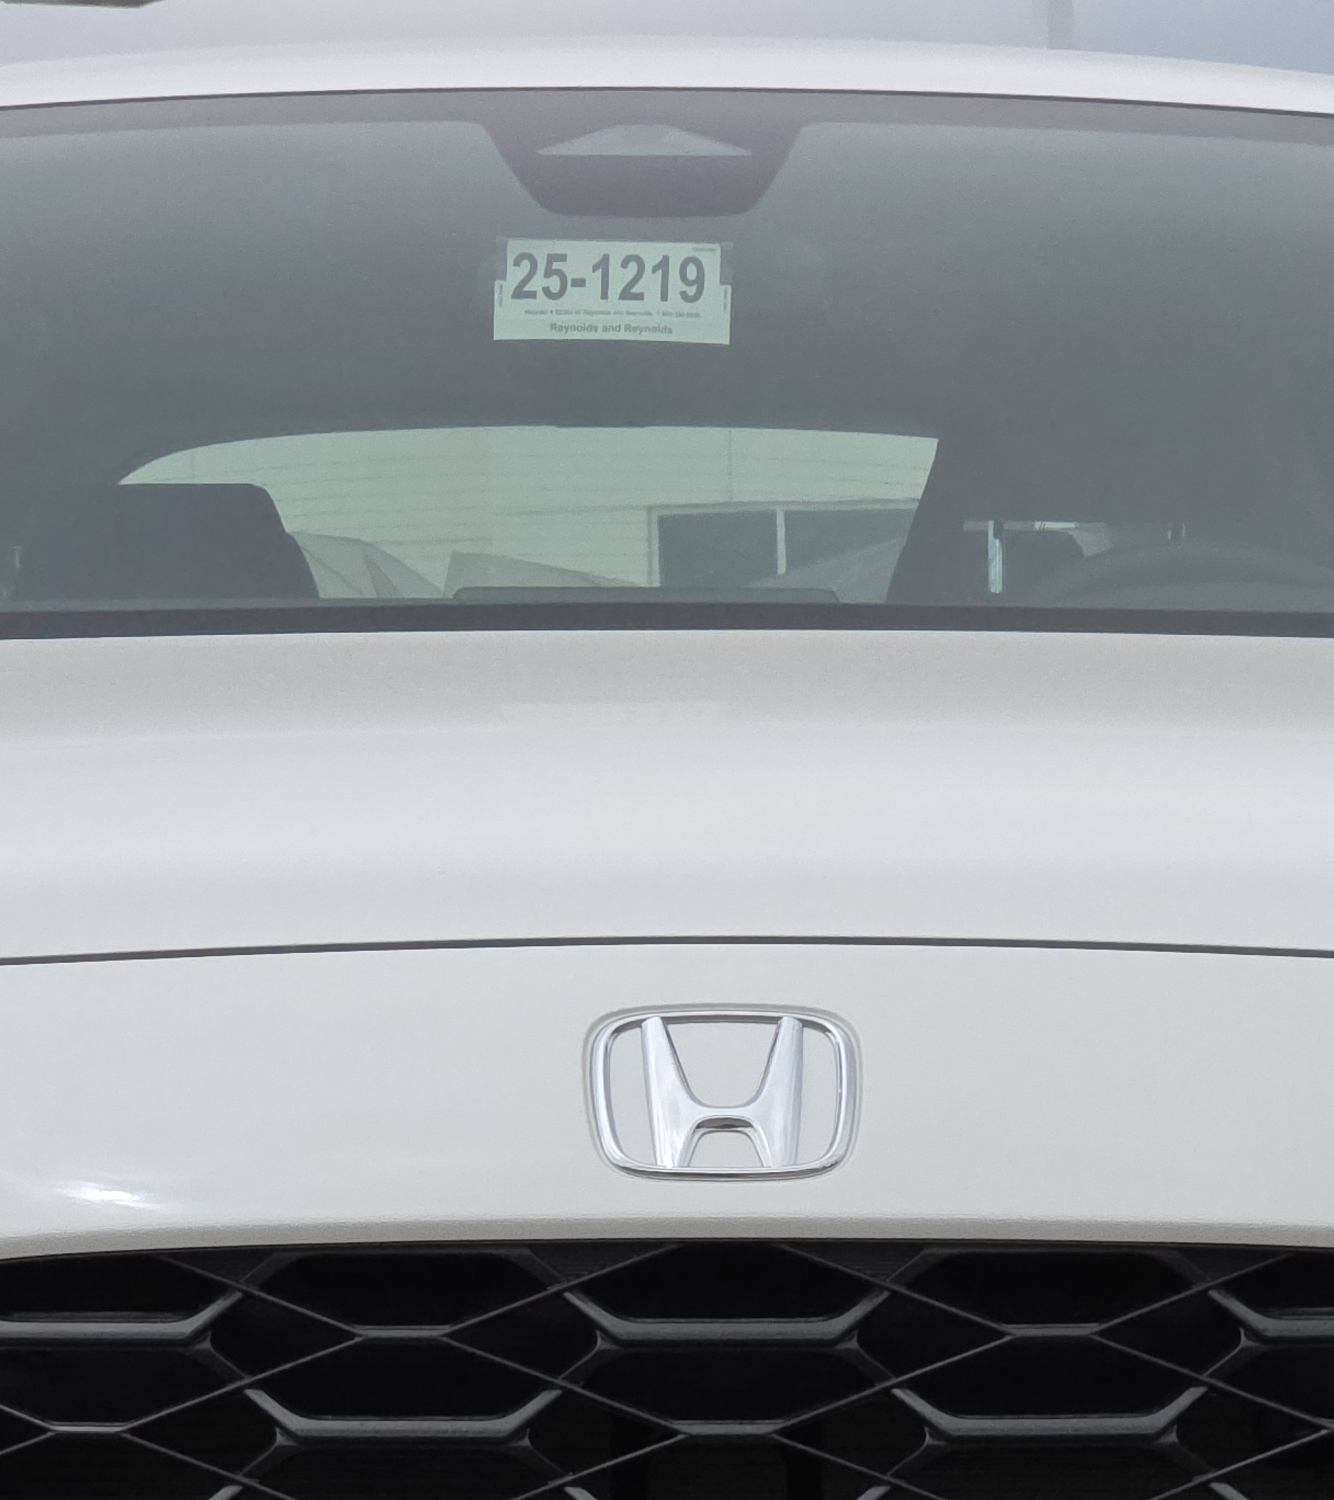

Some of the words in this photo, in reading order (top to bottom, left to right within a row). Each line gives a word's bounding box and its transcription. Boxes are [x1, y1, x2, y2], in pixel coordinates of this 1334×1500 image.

[511, 252, 706, 304] 25-1219
[549, 322, 599, 337] Reynolds
[601, 323, 622, 333] and
[624, 323, 673, 336] Reynolds
